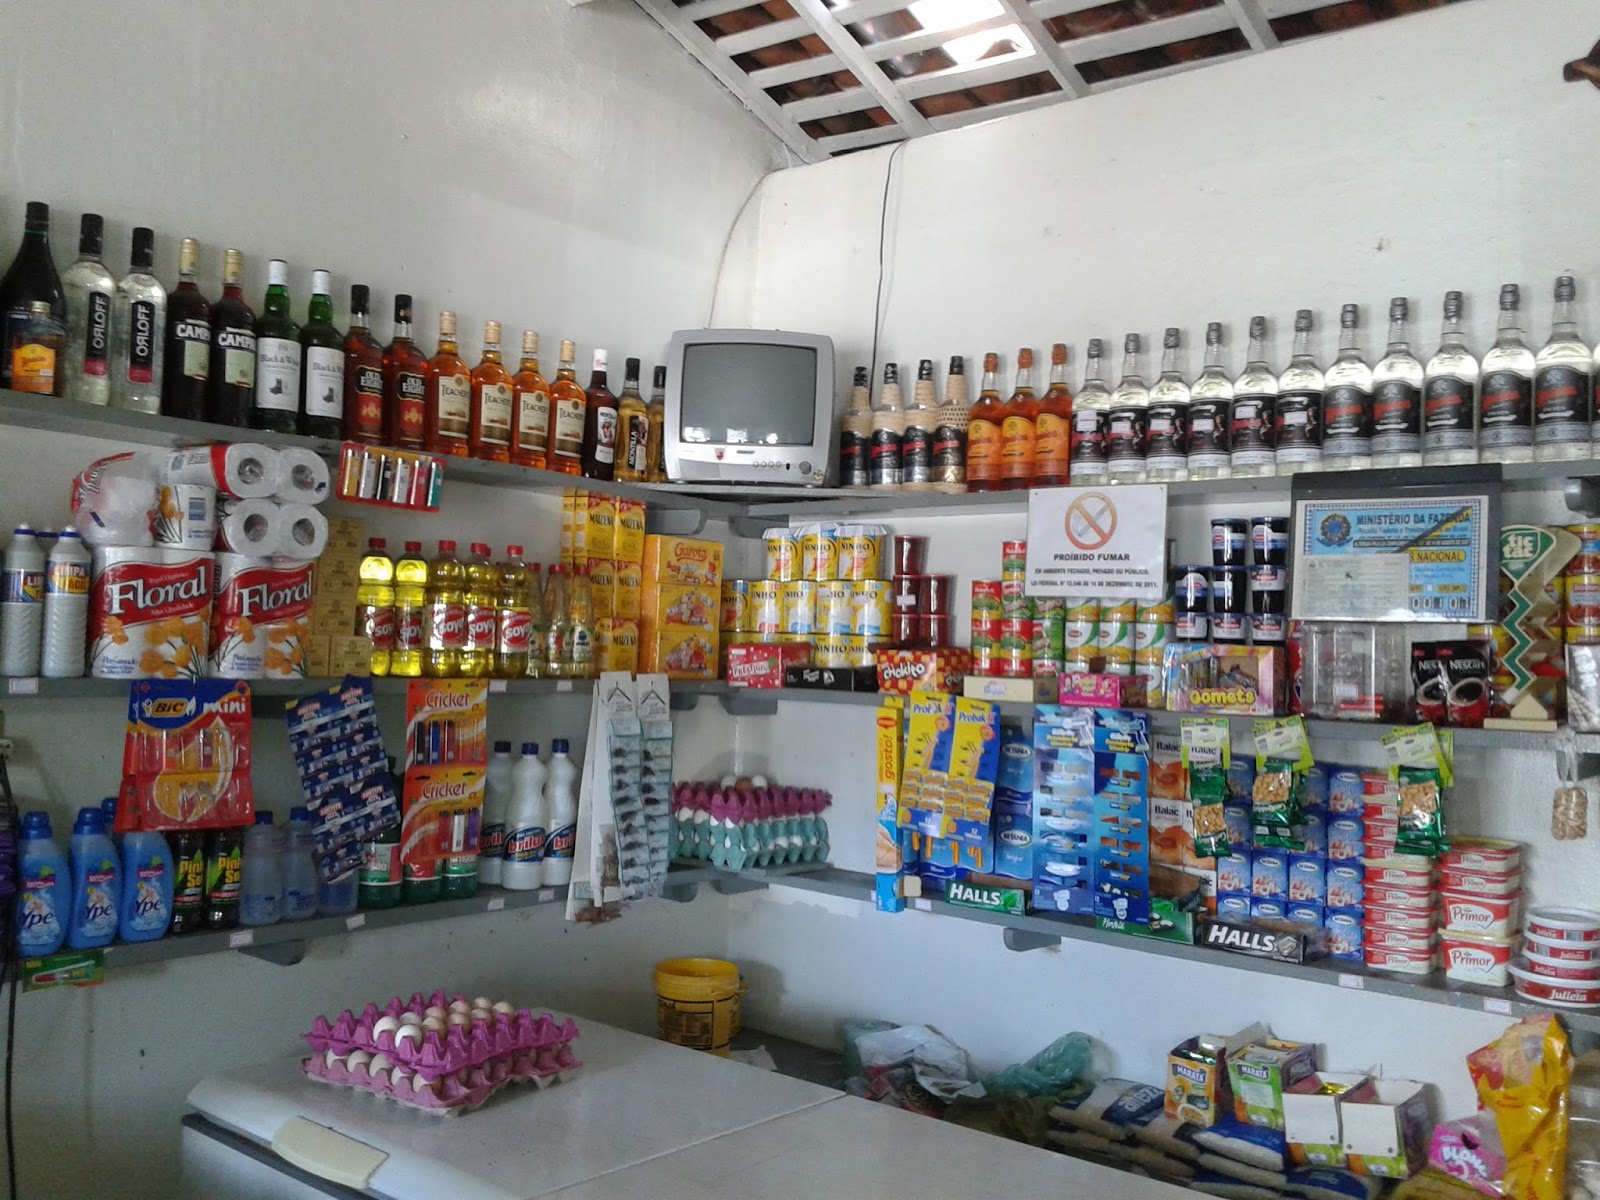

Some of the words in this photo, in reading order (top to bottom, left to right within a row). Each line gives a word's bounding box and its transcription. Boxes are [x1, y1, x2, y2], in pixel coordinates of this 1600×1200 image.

[93, 295, 109, 350] ORLOFF
[136, 304, 150, 357] ORLOFF
[361, 376, 384, 390] EIGHT
[365, 370, 381, 381] OLD
[406, 377, 422, 387] OLD
[402, 382, 426, 395] EIGHT
[628, 430, 638, 466] MONTILLA
[1356, 513, 1411, 526] MINISTÉRIO
[1413, 514, 1425, 525] DA
[841, 542, 870, 550] NINHO
[1507, 533, 1534, 547] tic
[674, 542, 707, 561] Garoto
[1097, 553, 1131, 561] FUMAR
[1417, 551, 1463, 561] NACIONAL
[1502, 546, 1534, 559] tac
[54, 565, 85, 578] LIMPA
[106, 565, 208, 615] Floral
[237, 570, 312, 617] Floral
[203, 698, 246, 714] mini
[425, 690, 470, 708] Cricket
[1156, 741, 1181, 753] Italac
[884, 734, 896, 780] gosto!
[422, 781, 468, 800] Cricket
[1154, 804, 1179, 817] Italac
[949, 882, 1001, 906] HALLS
[1451, 905, 1491, 923] Primor
[1208, 924, 1275, 952] HALLS
[1451, 949, 1491, 967] Primor
[1548, 989, 1587, 1001] Julieta
